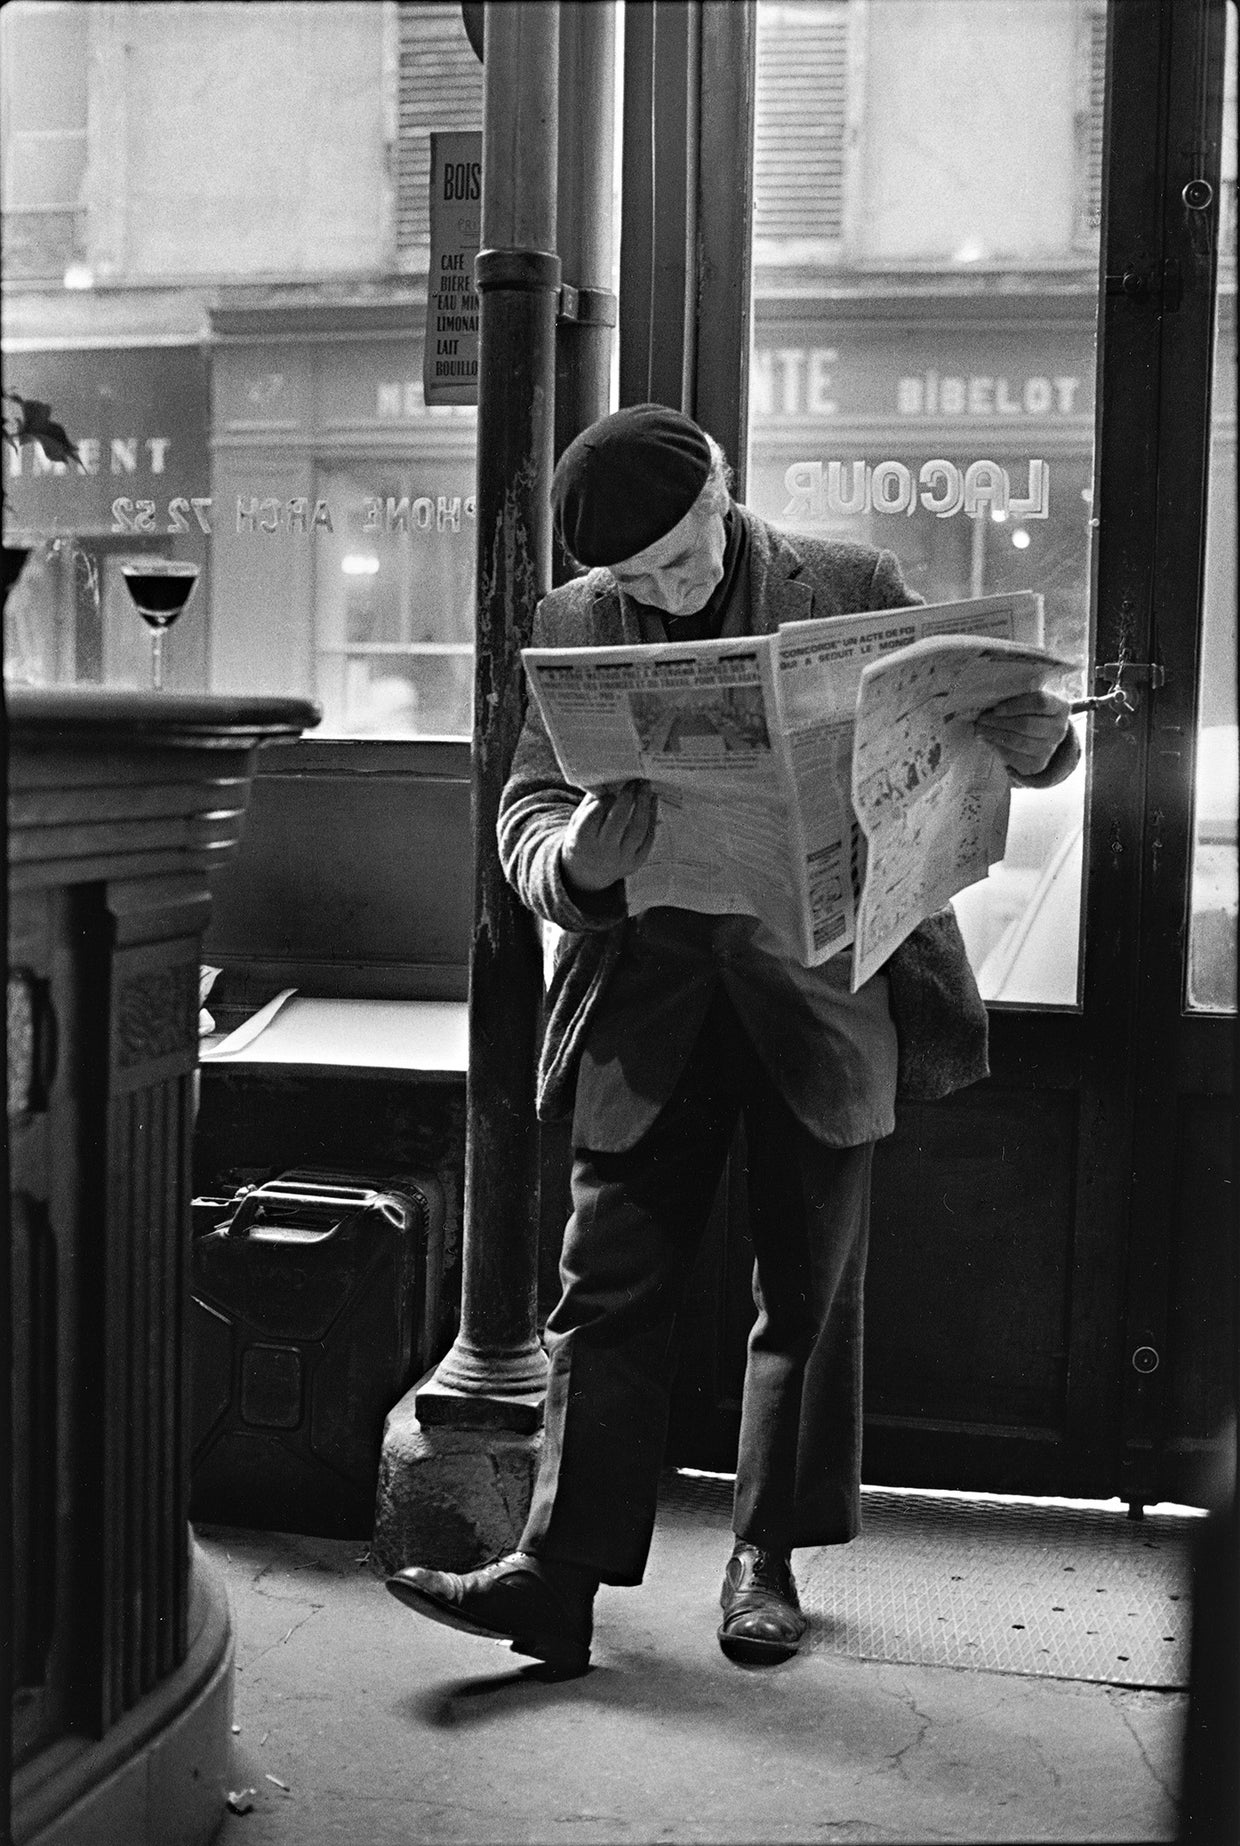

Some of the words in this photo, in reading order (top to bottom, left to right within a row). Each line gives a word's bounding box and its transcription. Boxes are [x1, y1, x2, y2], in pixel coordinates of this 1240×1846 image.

[444, 162, 481, 200] BOIS
[437, 294, 456, 310] EAU
[436, 339, 459, 355] LAIT
[860, 632, 883, 644] ACTE
[885, 629, 898, 638] DE
[861, 644, 871, 654] LE
